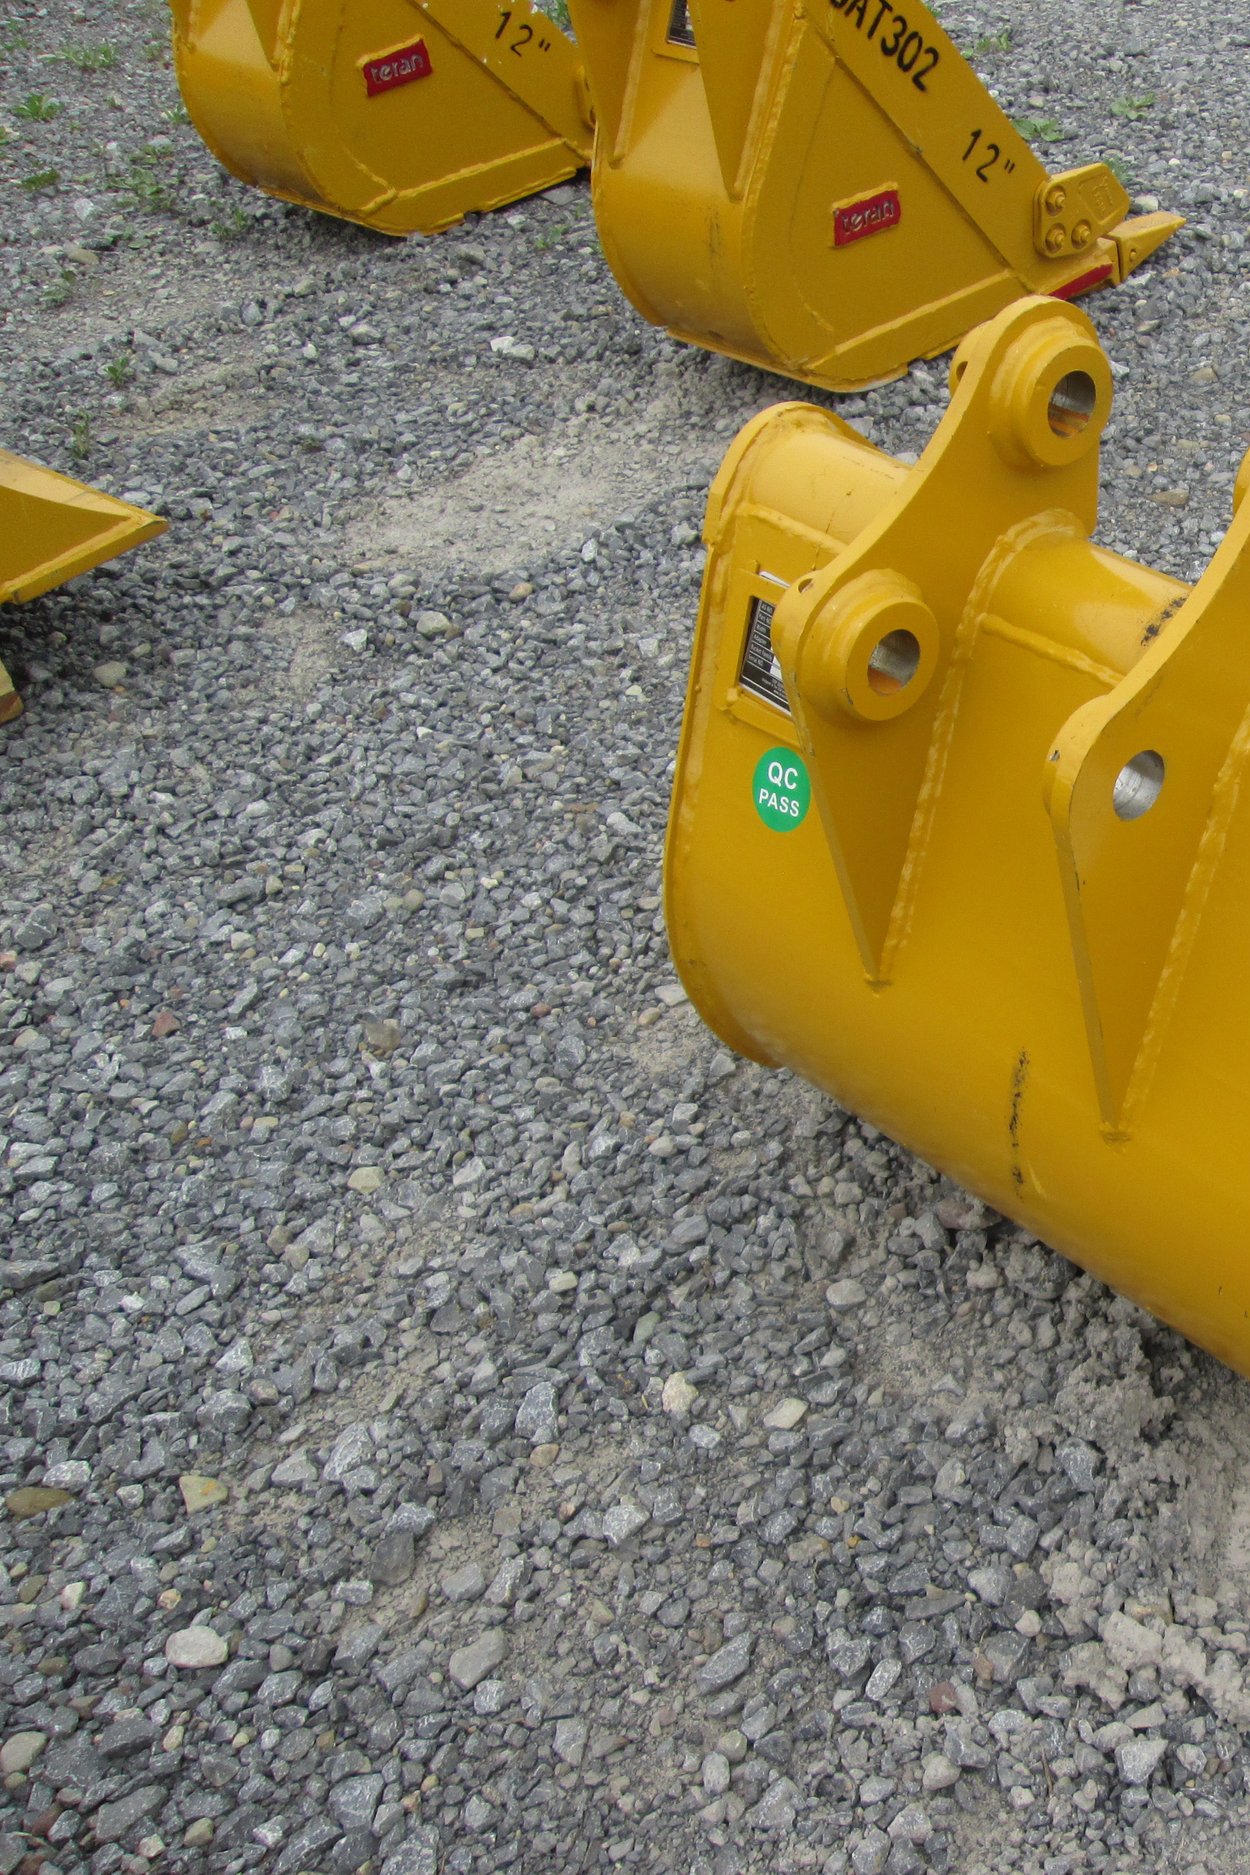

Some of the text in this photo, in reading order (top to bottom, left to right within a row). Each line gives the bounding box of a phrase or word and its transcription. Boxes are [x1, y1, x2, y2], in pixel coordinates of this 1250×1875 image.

[496, 11, 551, 57] 12"
[371, 53, 424, 84] teran
[829, 0, 1015, 183] AT302 12"
[841, 200, 894, 235] teran
[768, 761, 798, 790] QC
[759, 788, 799, 817] PASS
